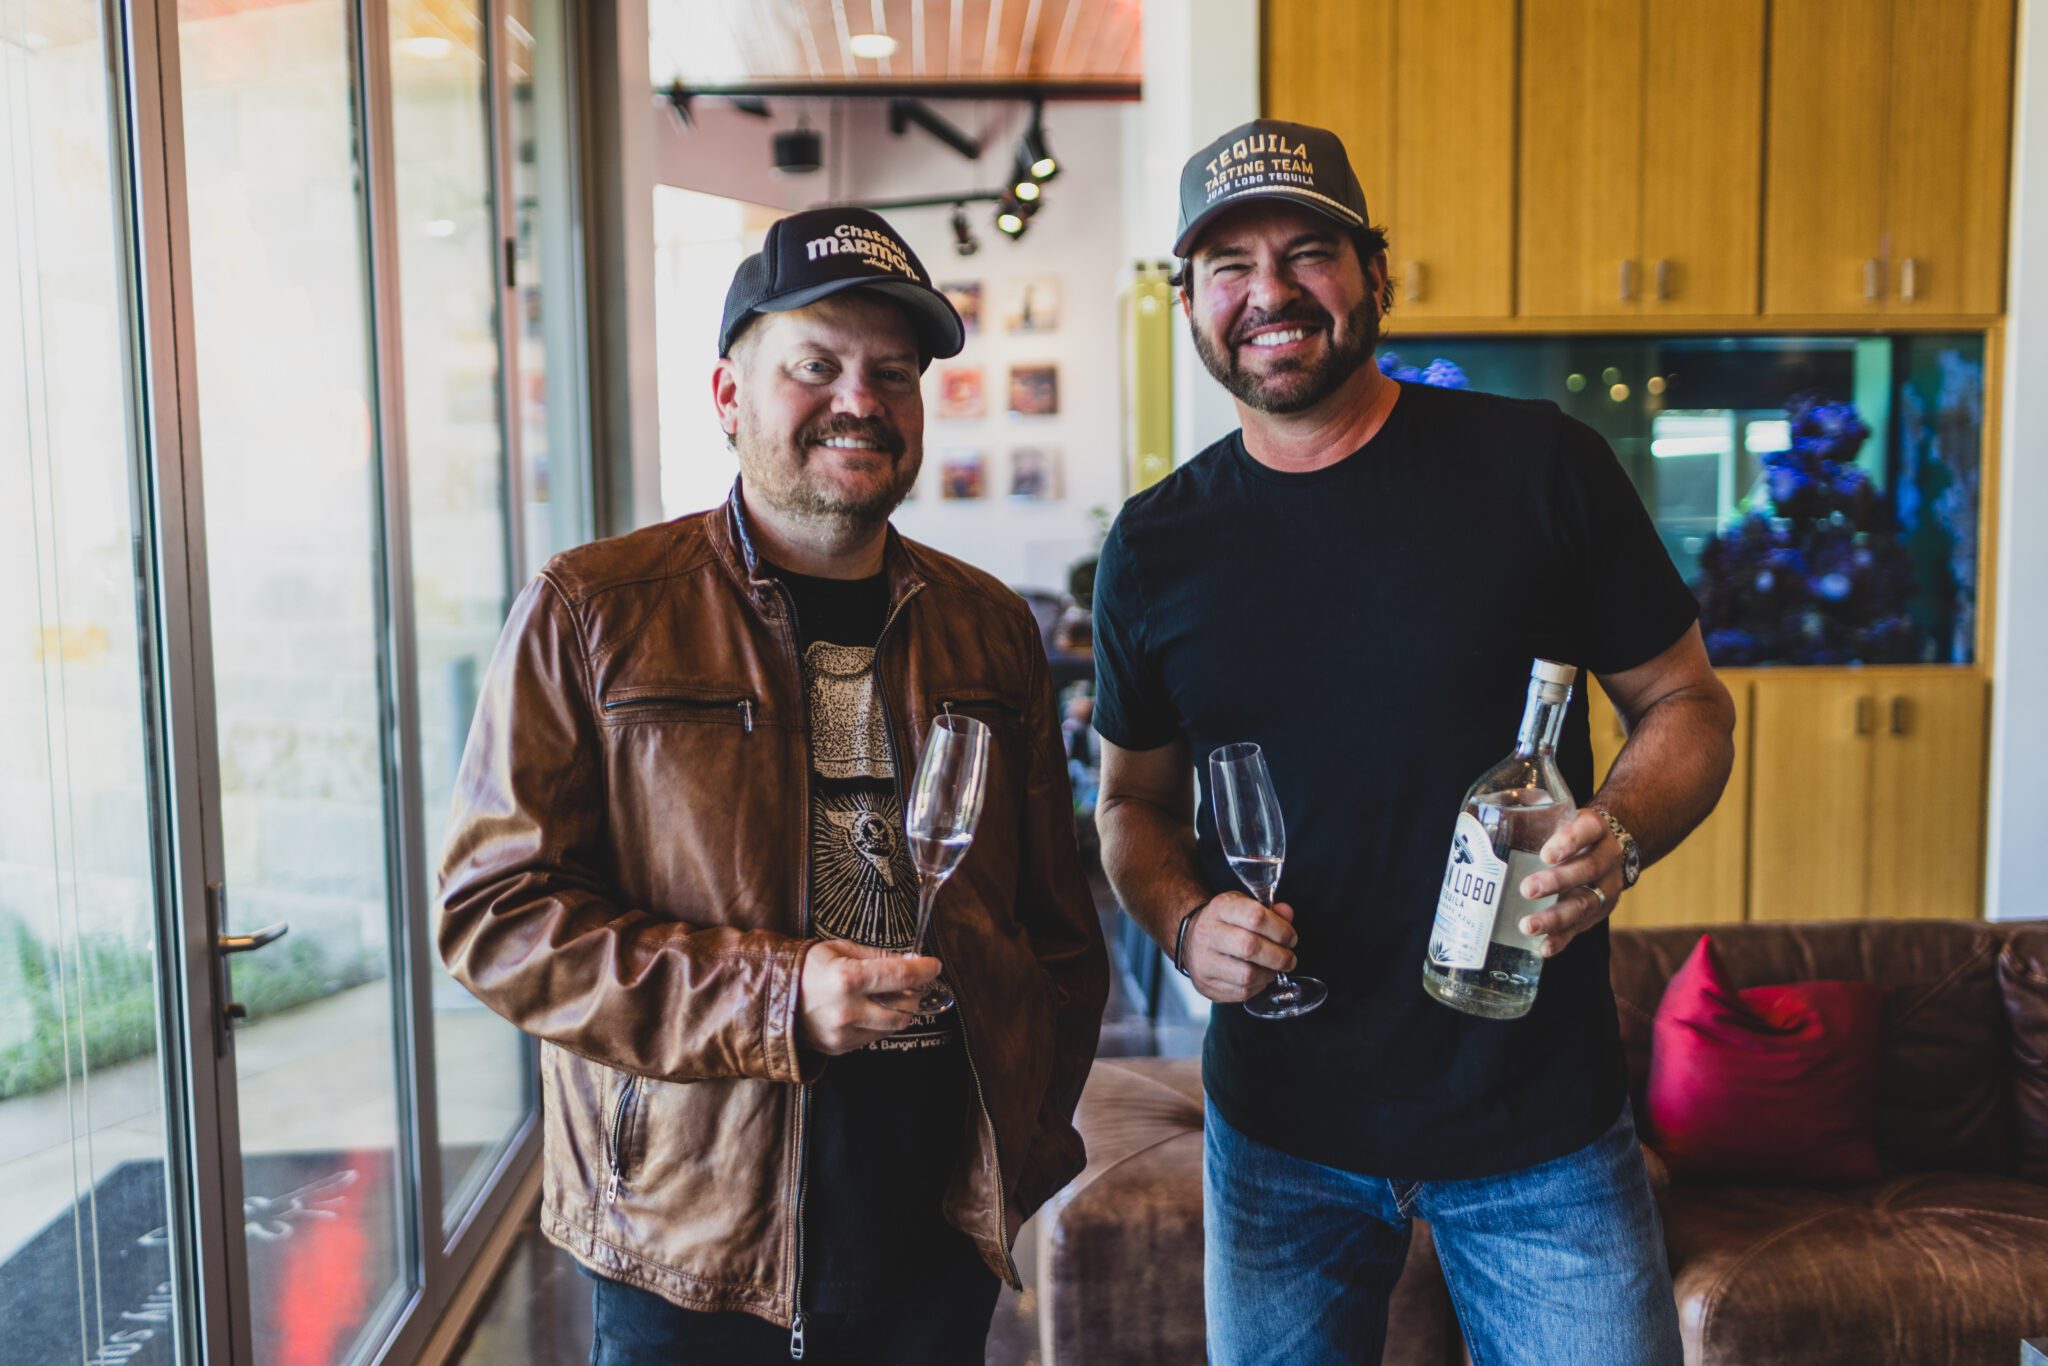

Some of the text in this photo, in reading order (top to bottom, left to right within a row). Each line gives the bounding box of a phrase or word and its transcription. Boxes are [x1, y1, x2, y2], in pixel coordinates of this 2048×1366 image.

[1206, 134, 1307, 175] TEQUILA
[1204, 158, 1314, 193] TASTING TEAM
[1206, 172, 1314, 203] JUAN LOBO TEQUILA
[834, 224, 908, 261] Chateau
[1454, 868, 1496, 905] LOBO
[925, 1014, 936, 1025] TX
[869, 1040, 878, 1050] &
[881, 1038, 919, 1051] Bangin'
